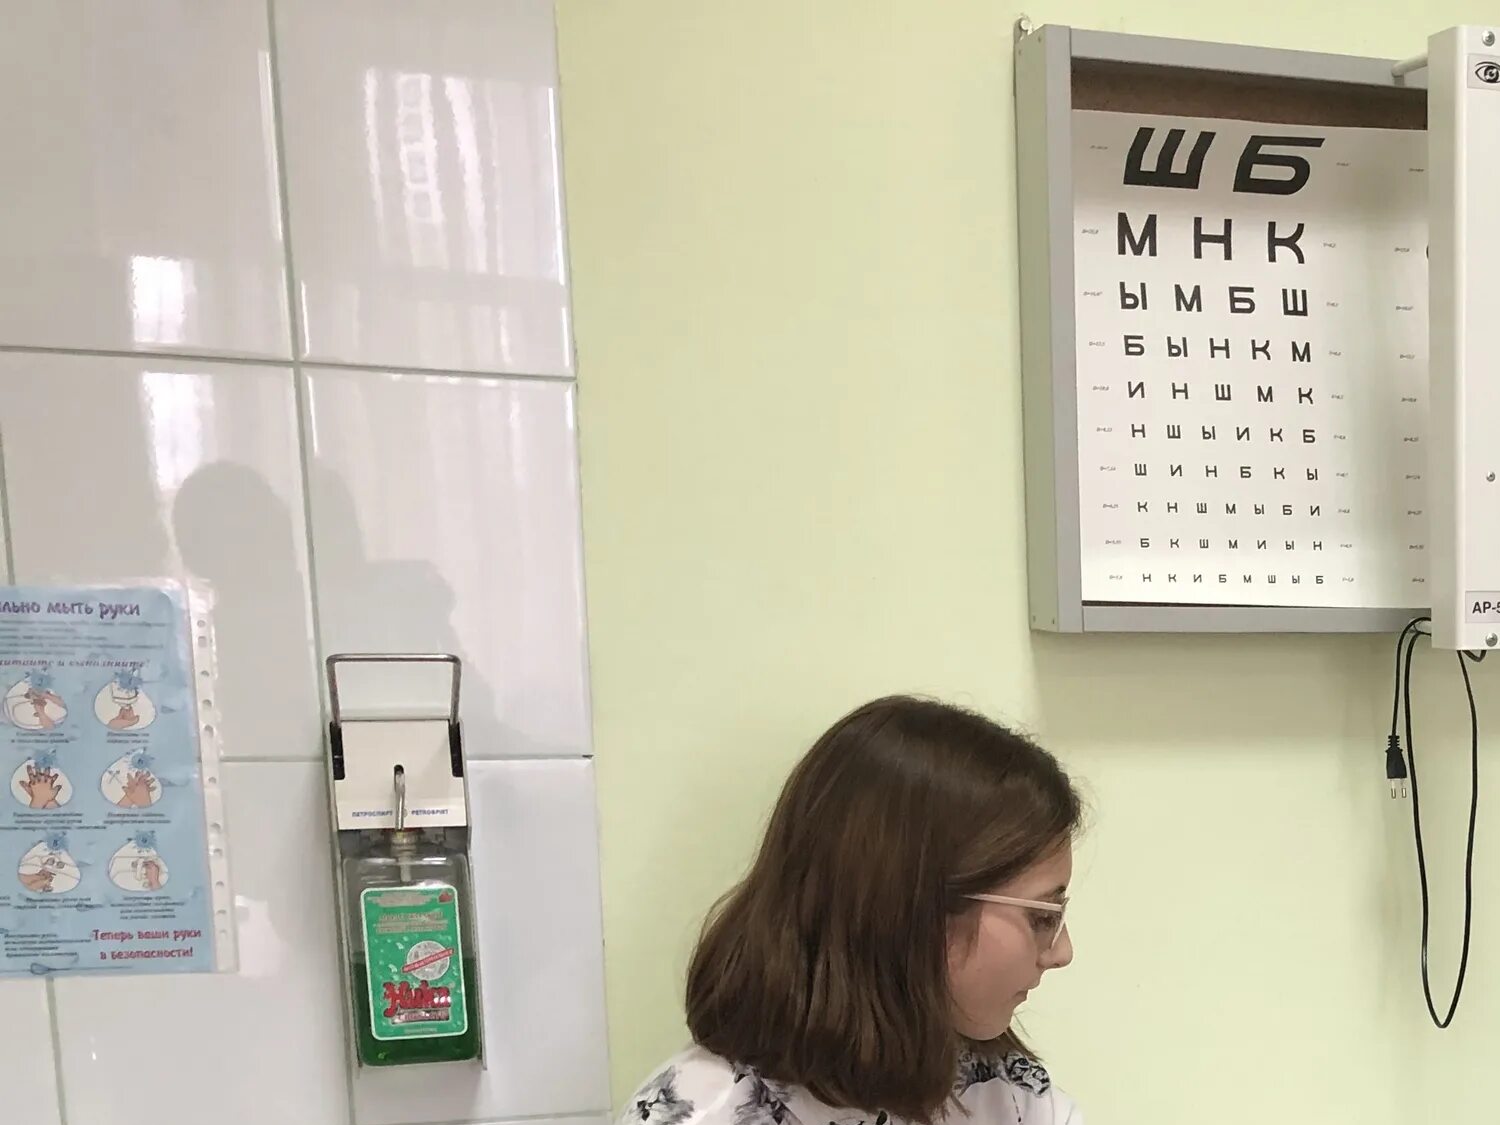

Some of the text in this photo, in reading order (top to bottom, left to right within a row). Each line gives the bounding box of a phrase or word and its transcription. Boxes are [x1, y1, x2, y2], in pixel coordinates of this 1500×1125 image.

[1124, 127, 1326, 196] Ш Б
[1117, 212, 1306, 265] М Н К
[1119, 282, 1309, 317] Ы М Б Ш
[1124, 335, 1312, 363] Б Ы Н К М
[1128, 381, 1314, 405] И Н Ш М К
[1131, 424, 1316, 444] Н Ш Ы И К Б
[1134, 464, 1319, 482] Ш И Н Б К Ы
[1138, 502, 1321, 517] К Н Ш М Ы Б И
[1140, 538, 1323, 552] Б К Ш М И Ы Н
[1143, 574, 1325, 585] Н К И Б М Ш Ы Б
[47, 602, 95, 616] мыть
[98, 602, 141, 620] руки
[92, 929, 201, 943] Теперь ваши руки
[111, 946, 194, 960] безопасности!
